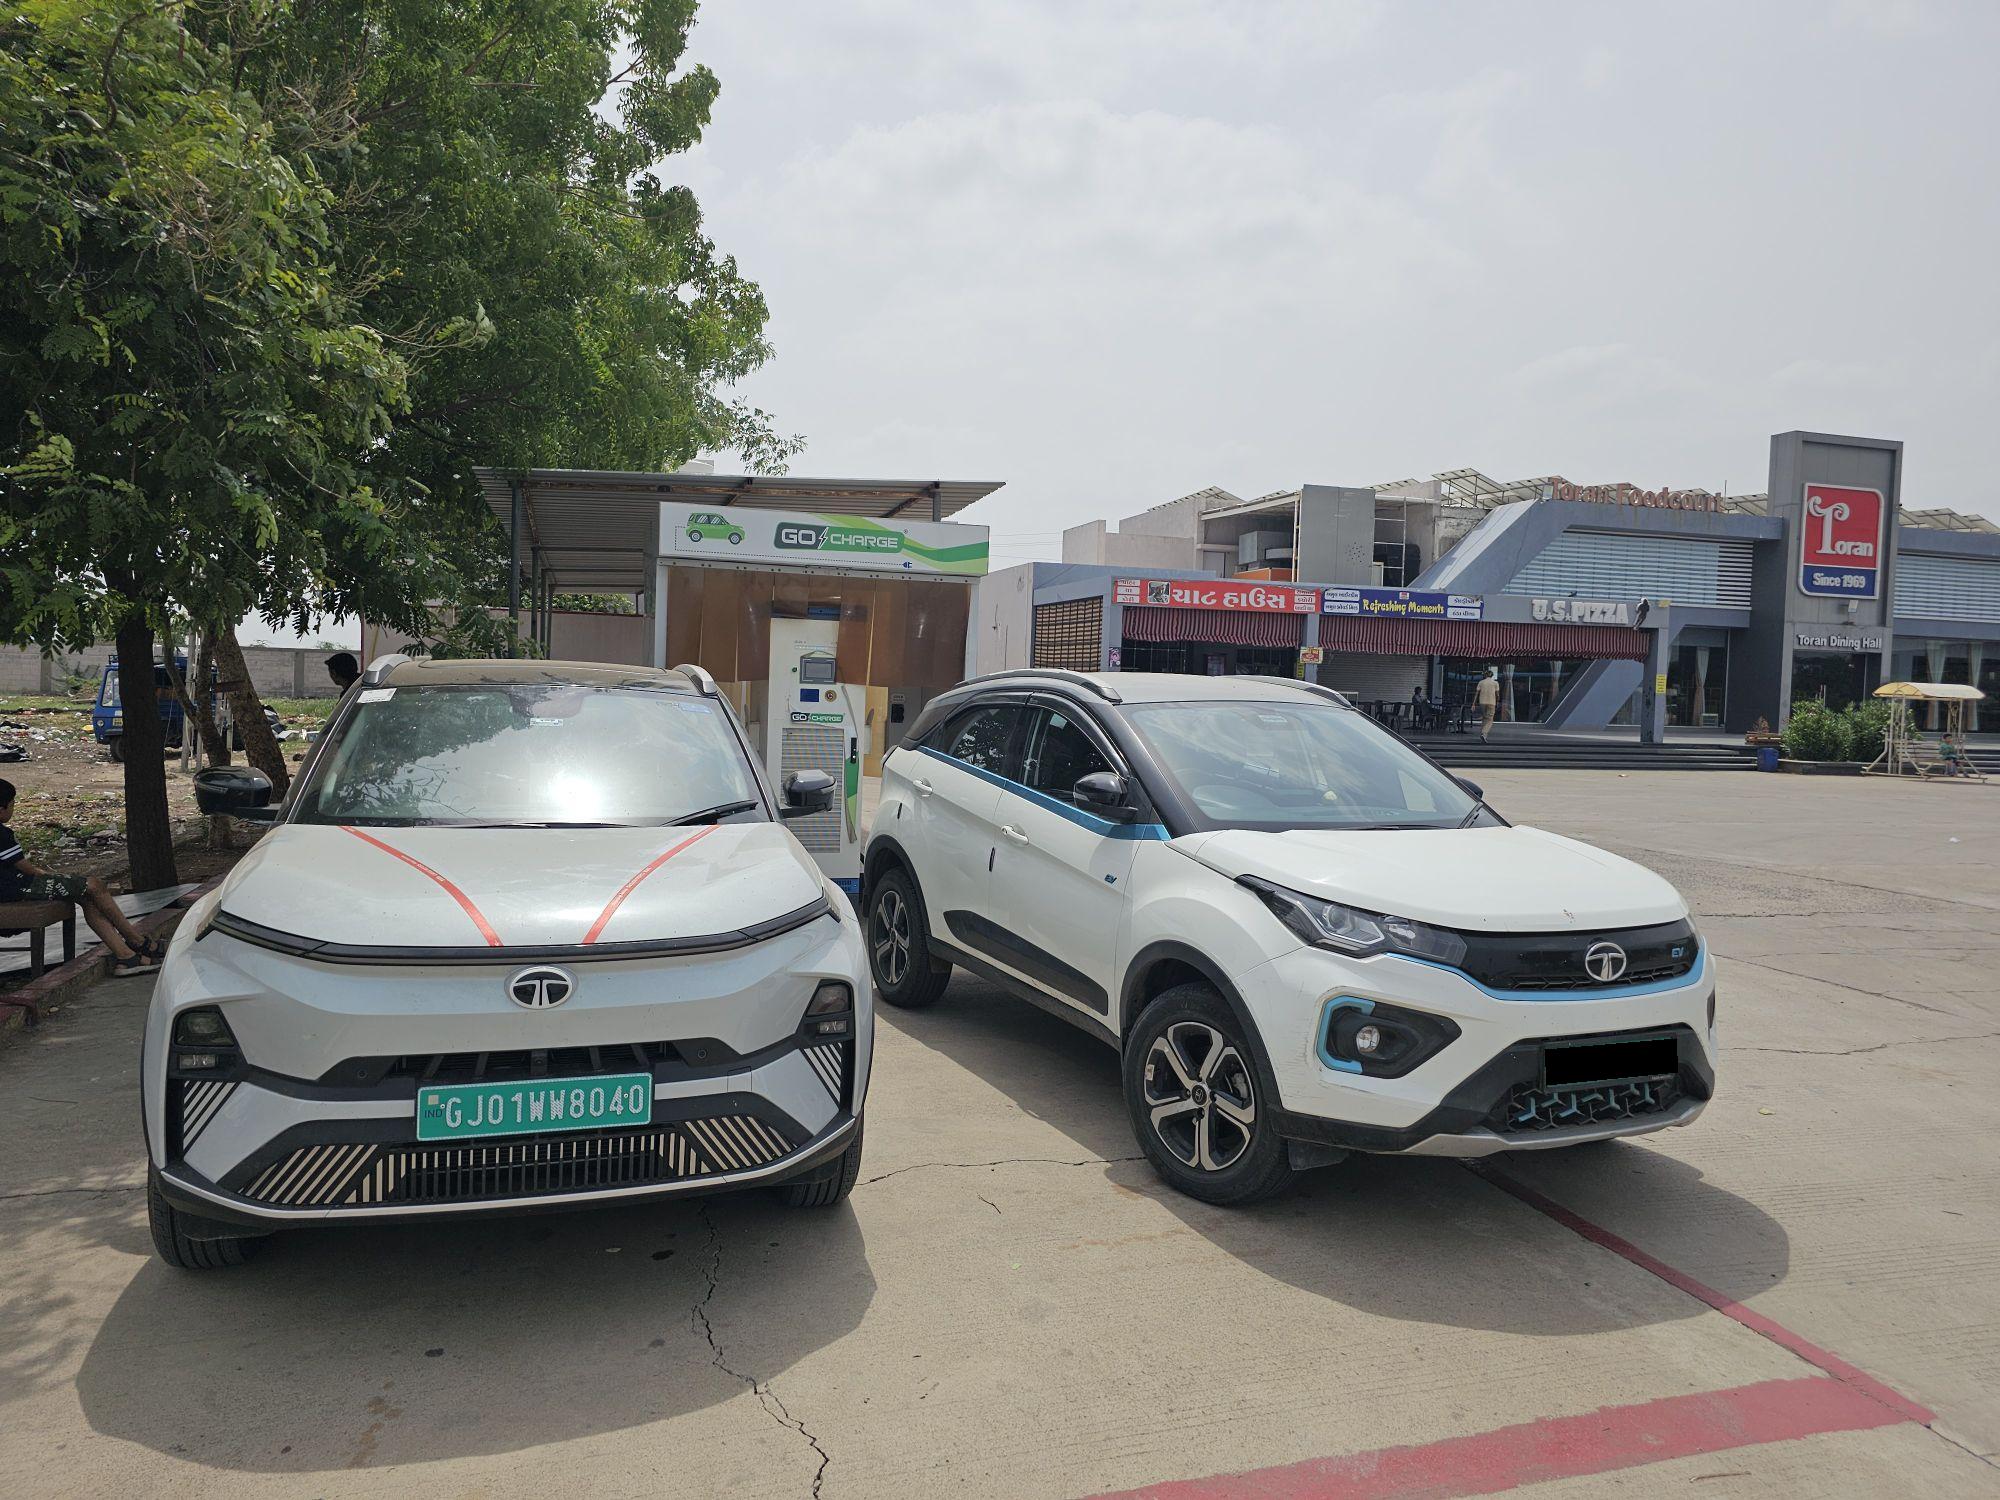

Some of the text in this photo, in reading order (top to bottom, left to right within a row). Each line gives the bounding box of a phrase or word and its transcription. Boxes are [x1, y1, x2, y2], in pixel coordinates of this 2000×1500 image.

[1548, 476, 1727, 513] Toran Foodcourt
[1807, 495, 1874, 557] Toran
[781, 528, 899, 549] GO CHARGE
[1812, 572, 1866, 589] Since 1969
[1171, 587, 1286, 609] ચાટ હાઉસ
[1362, 598, 1407, 616] Refreshing
[1408, 601, 1445, 615] Moments
[1797, 634, 1883, 651] Toran Dining Hall
[792, 713, 808, 721] GO
[424, 1109, 442, 1119] IND
[445, 1083, 644, 1128] GJ01WW8040
